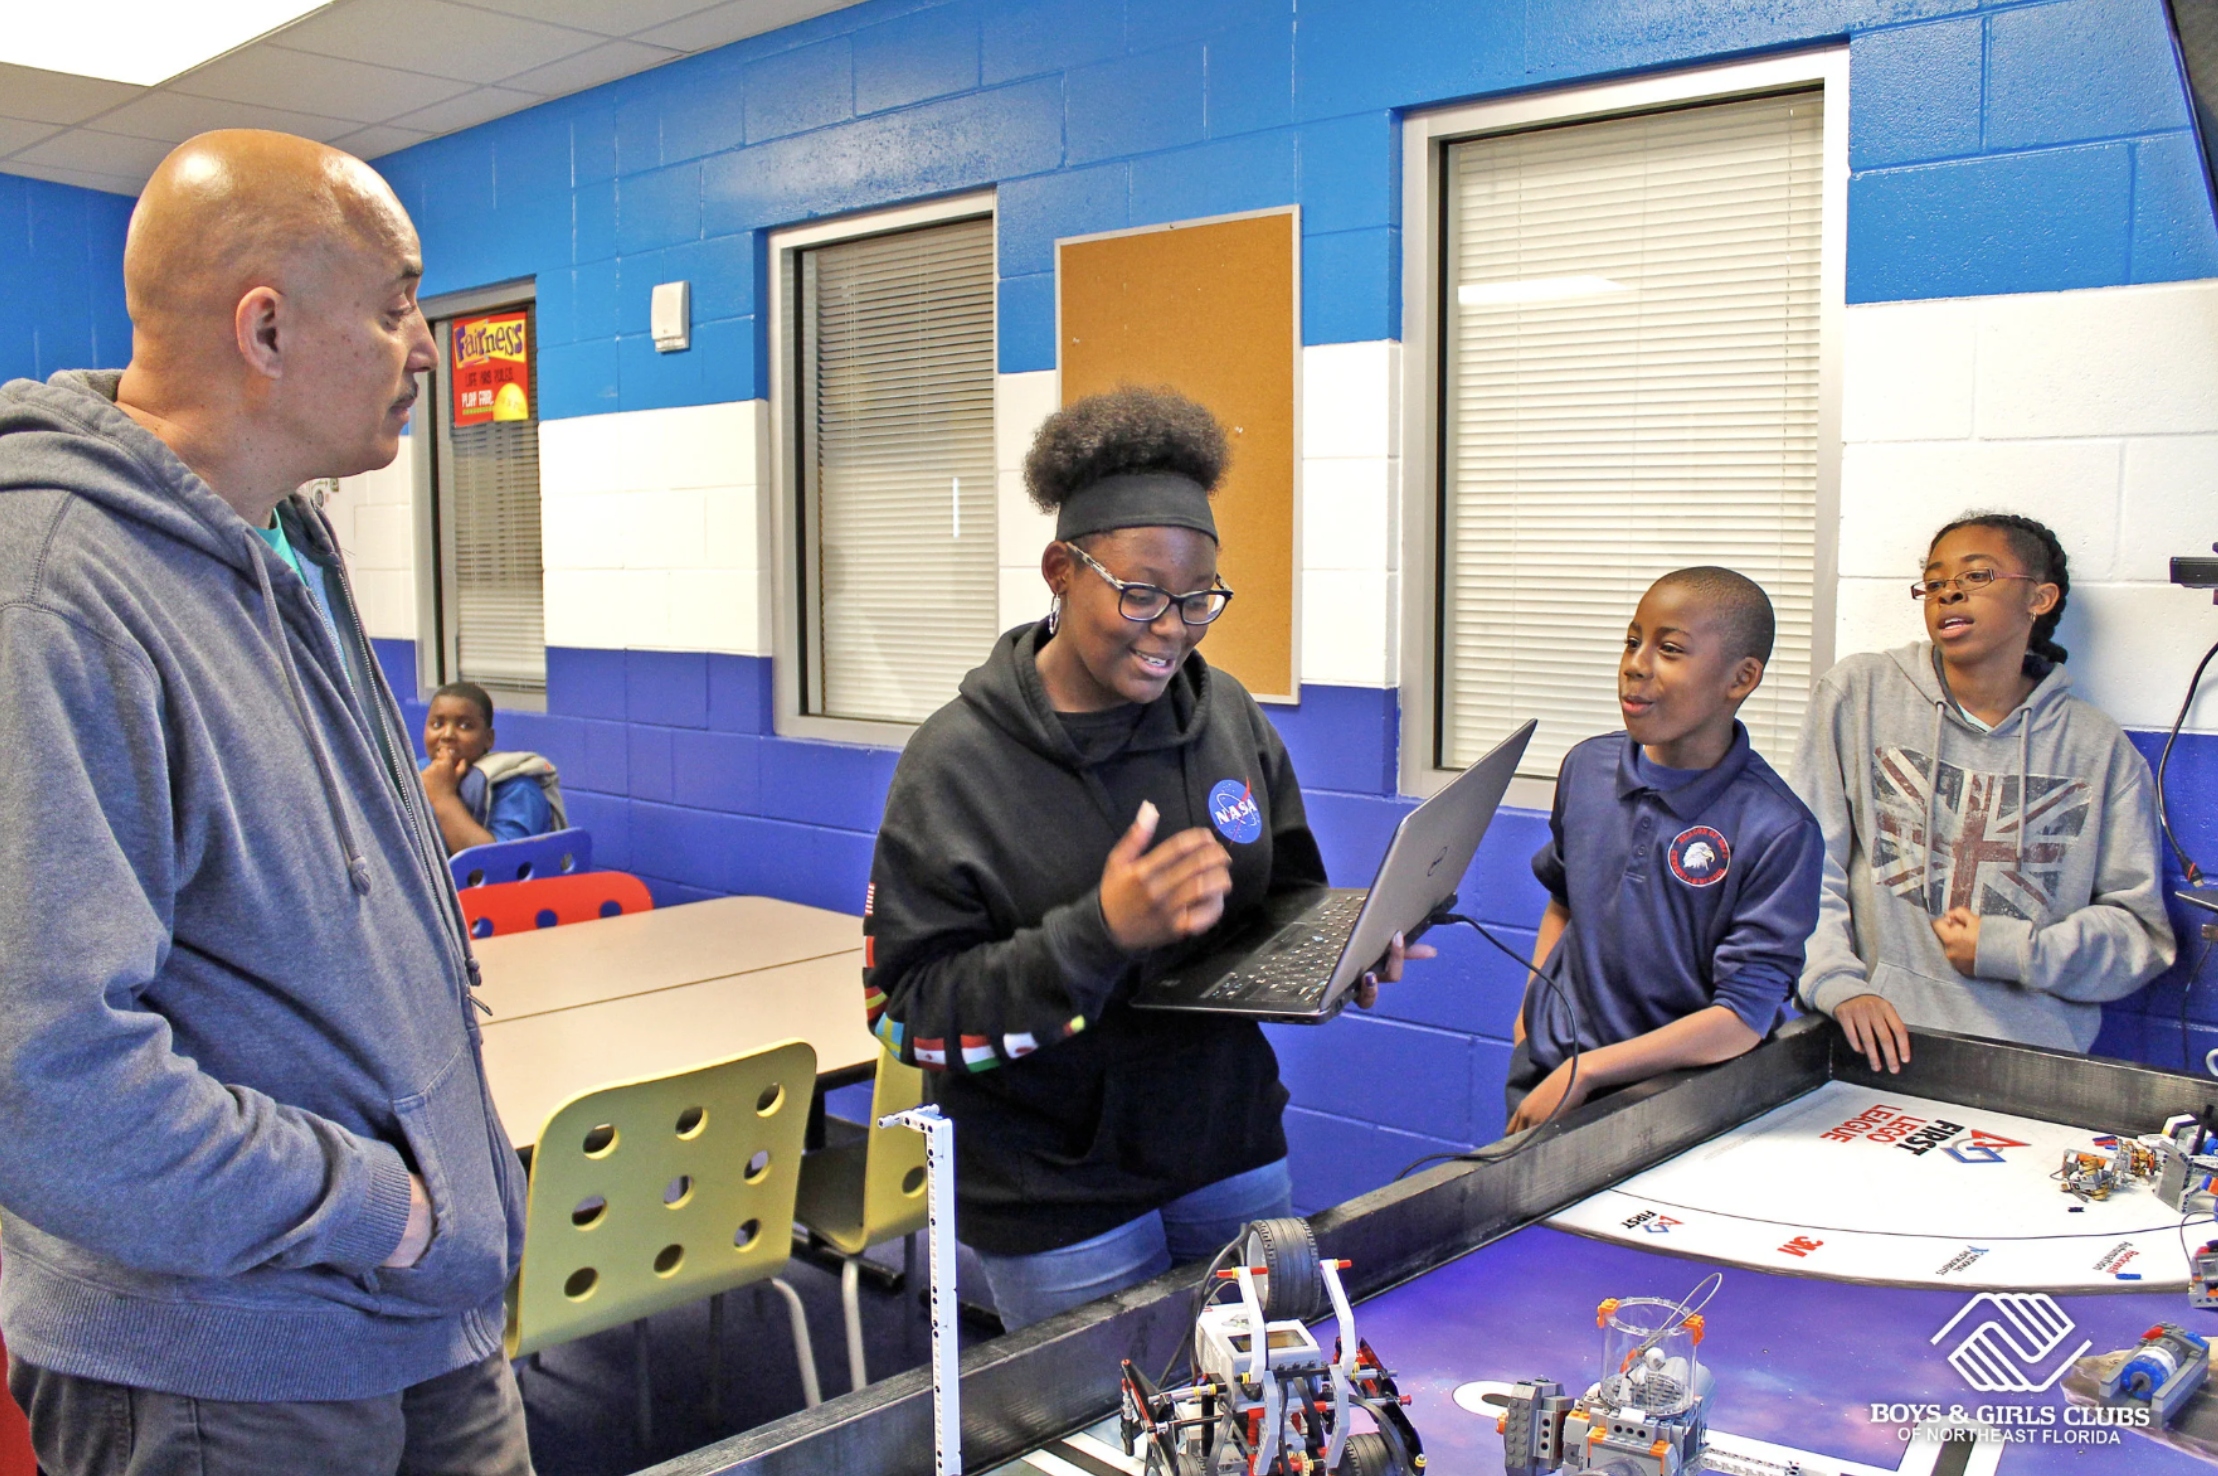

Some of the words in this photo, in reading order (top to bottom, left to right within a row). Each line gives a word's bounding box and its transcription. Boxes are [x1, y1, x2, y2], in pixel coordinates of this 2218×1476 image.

[455, 323, 523, 362] Fairness
[1215, 798, 1258, 824] NASA
[1819, 1104, 1903, 1143] LEAGUE
[1866, 1115, 1927, 1143] LEGO
[1896, 1119, 1965, 1156] FIRST
[1620, 1210, 1657, 1229] FIRST
[1777, 1236, 1824, 1257] 3M
